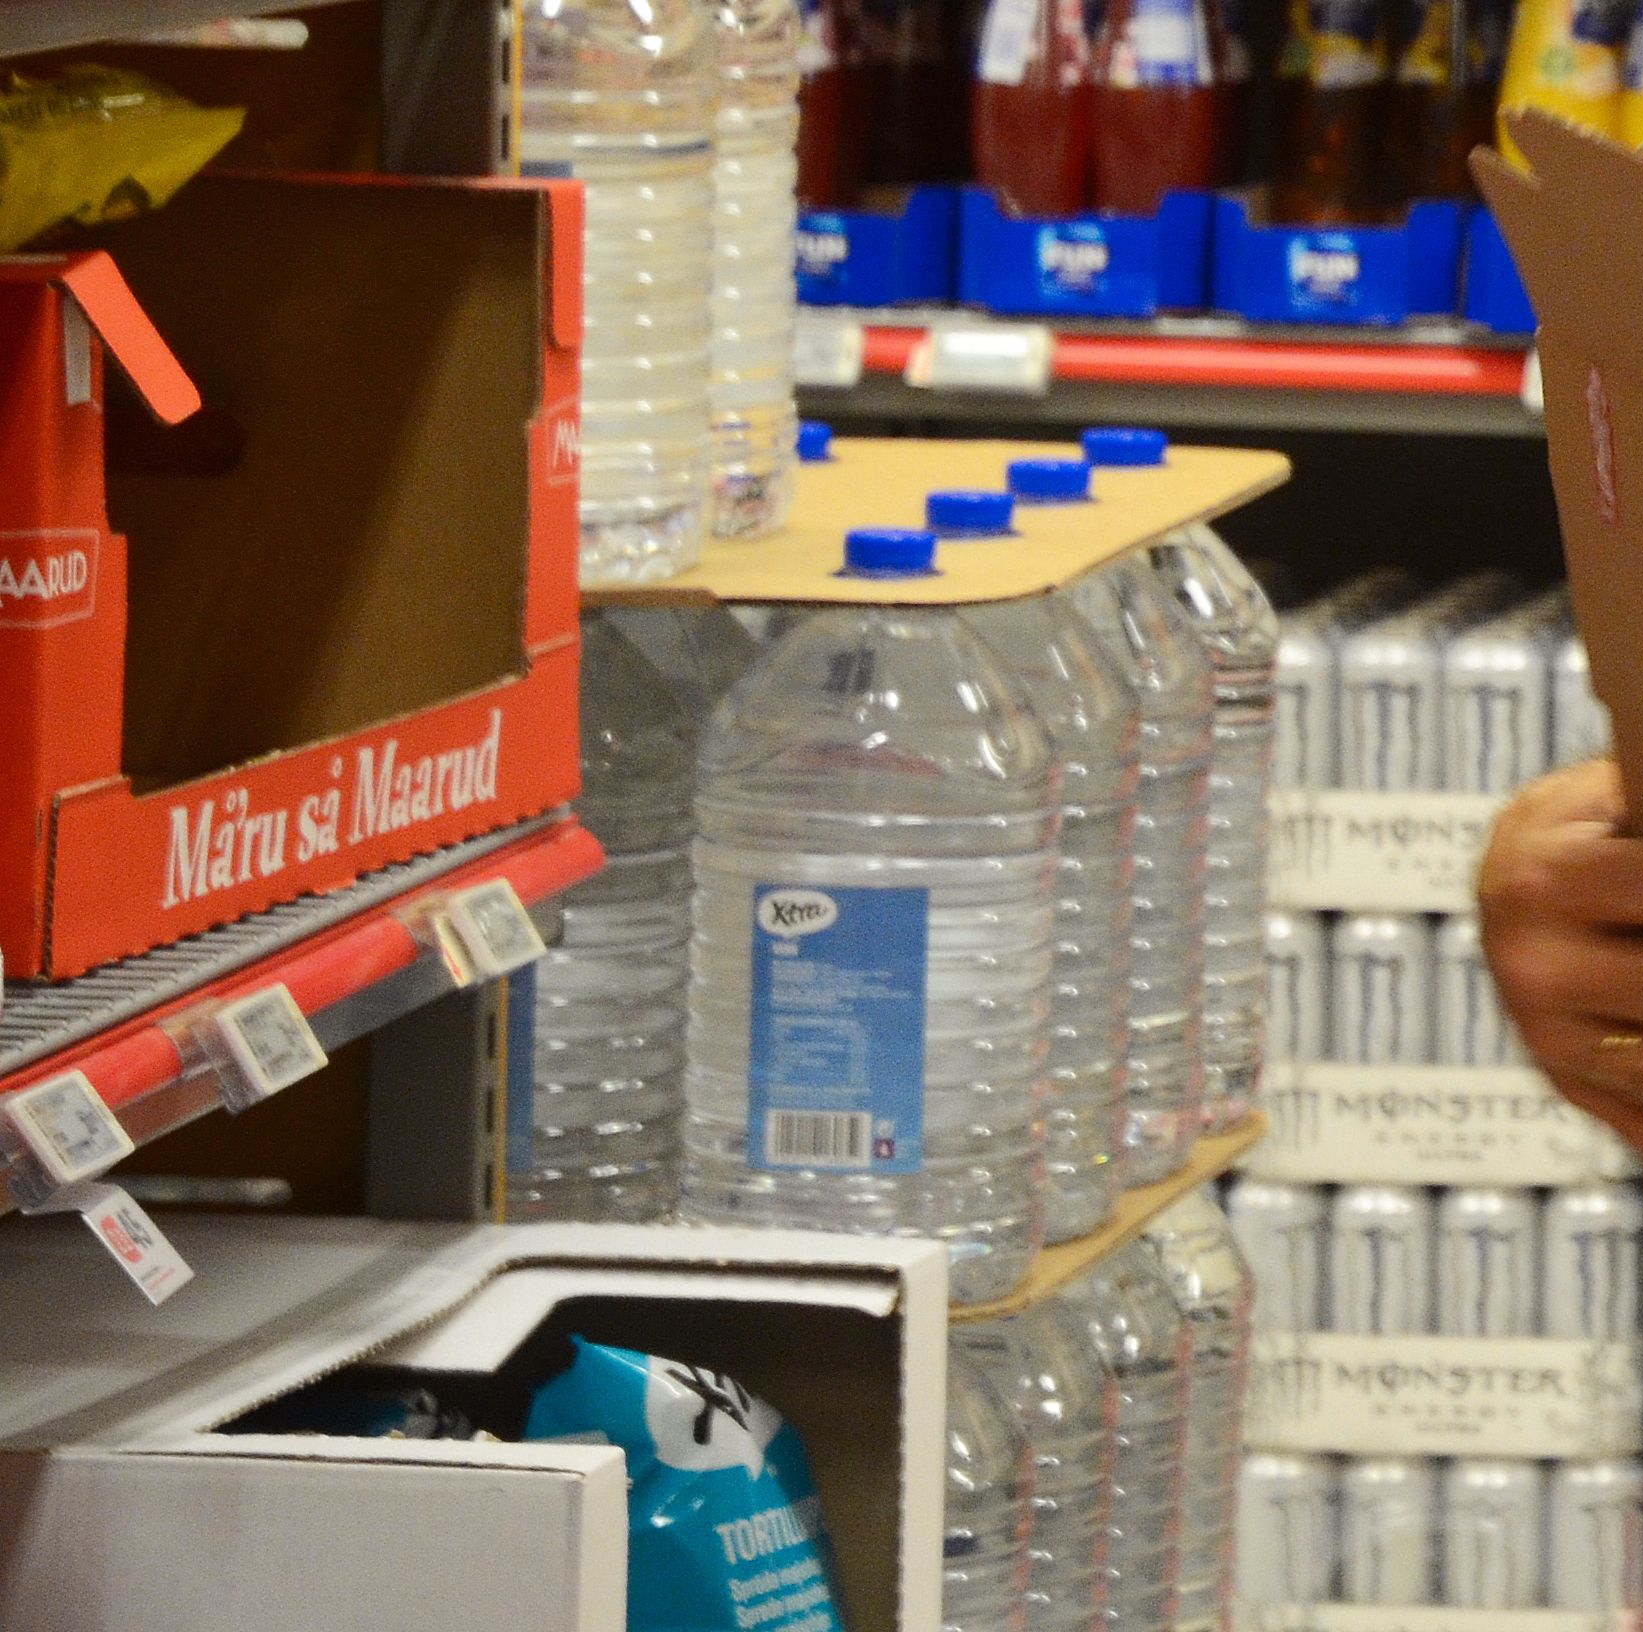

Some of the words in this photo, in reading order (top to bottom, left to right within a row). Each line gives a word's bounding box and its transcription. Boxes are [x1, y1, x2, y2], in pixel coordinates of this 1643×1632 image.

[0, 549, 89, 609] AARUD
[296, 755, 344, 864] så
[347, 707, 503, 847] Maarud
[1346, 816, 1486, 848] MONS
[771, 898, 829, 927] Xtra
[1336, 1363, 1568, 1398] MONSTER
